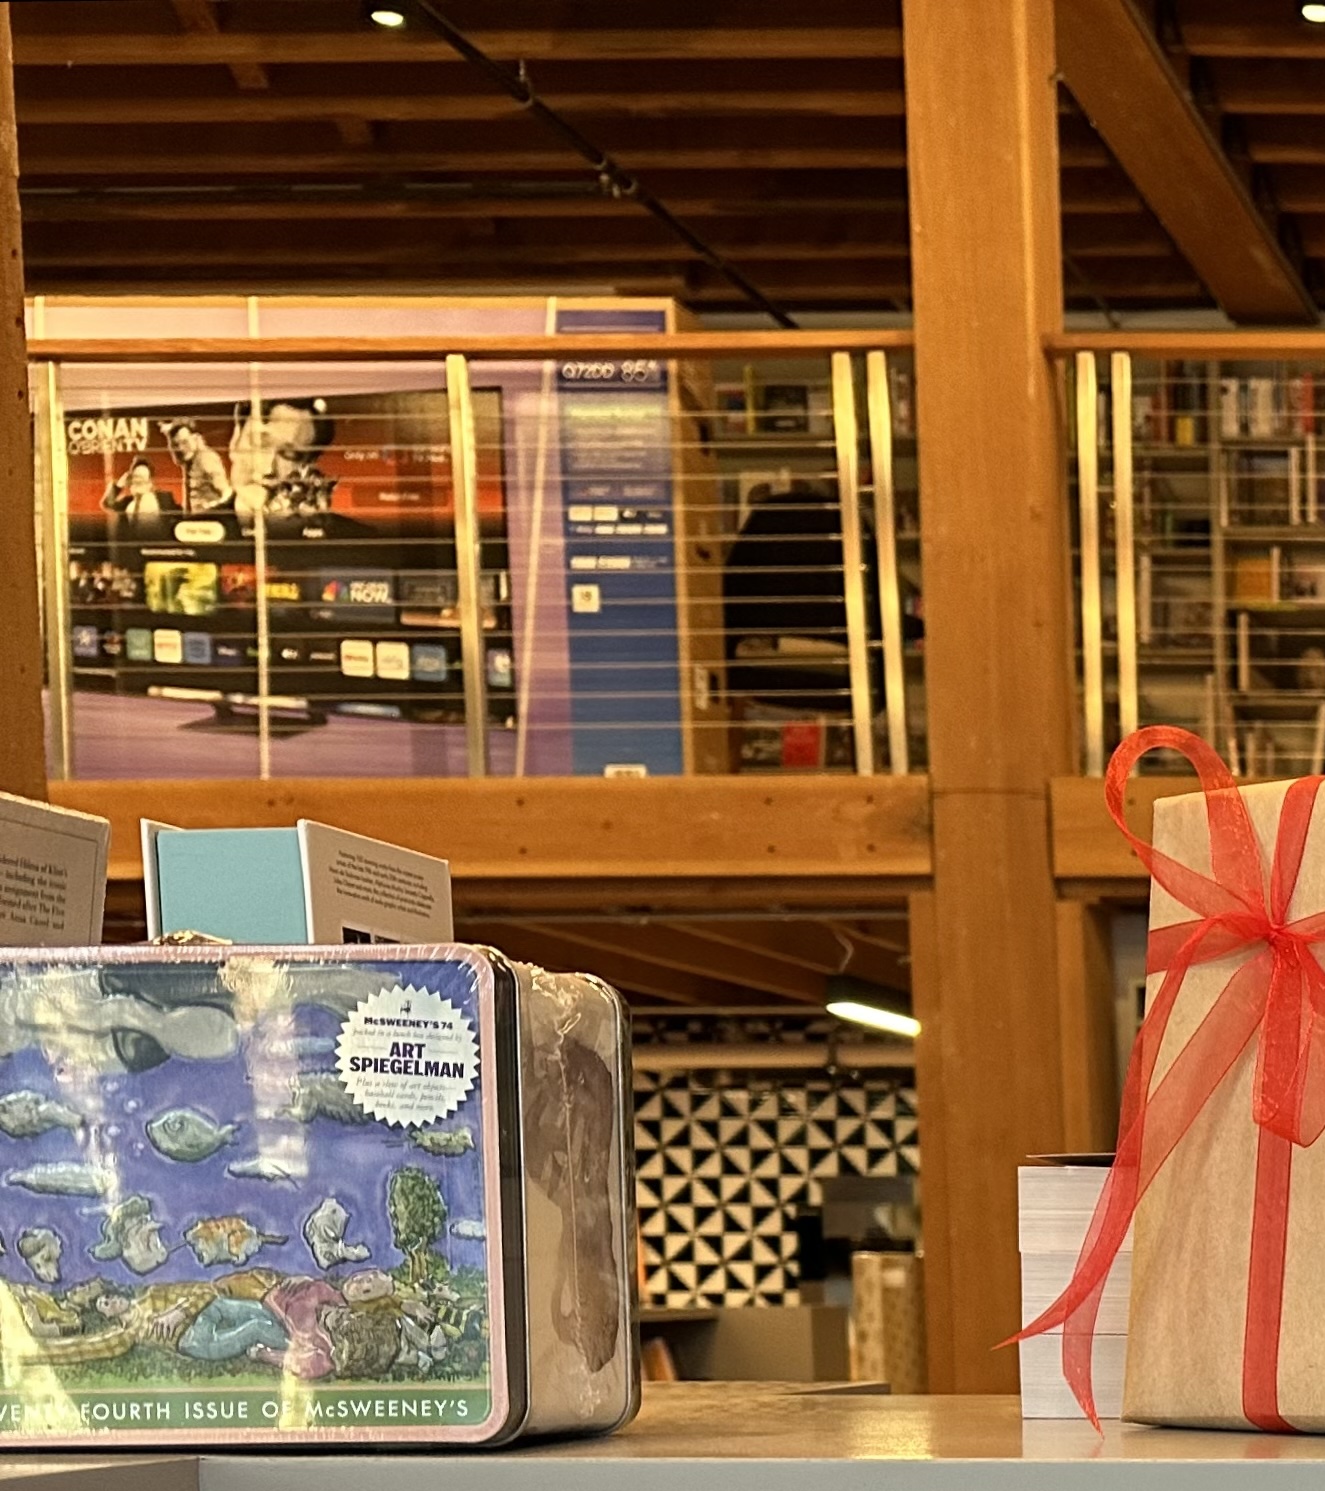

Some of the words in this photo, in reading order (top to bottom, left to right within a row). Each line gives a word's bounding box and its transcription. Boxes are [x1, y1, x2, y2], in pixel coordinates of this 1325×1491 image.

[68, 419, 148, 440] CONAN
[390, 1042, 426, 1058] ART
[350, 1057, 464, 1078] SPIEGELMAN
[80, 1403, 171, 1421] FOURTH
[184, 1401, 248, 1419] ISSUE
